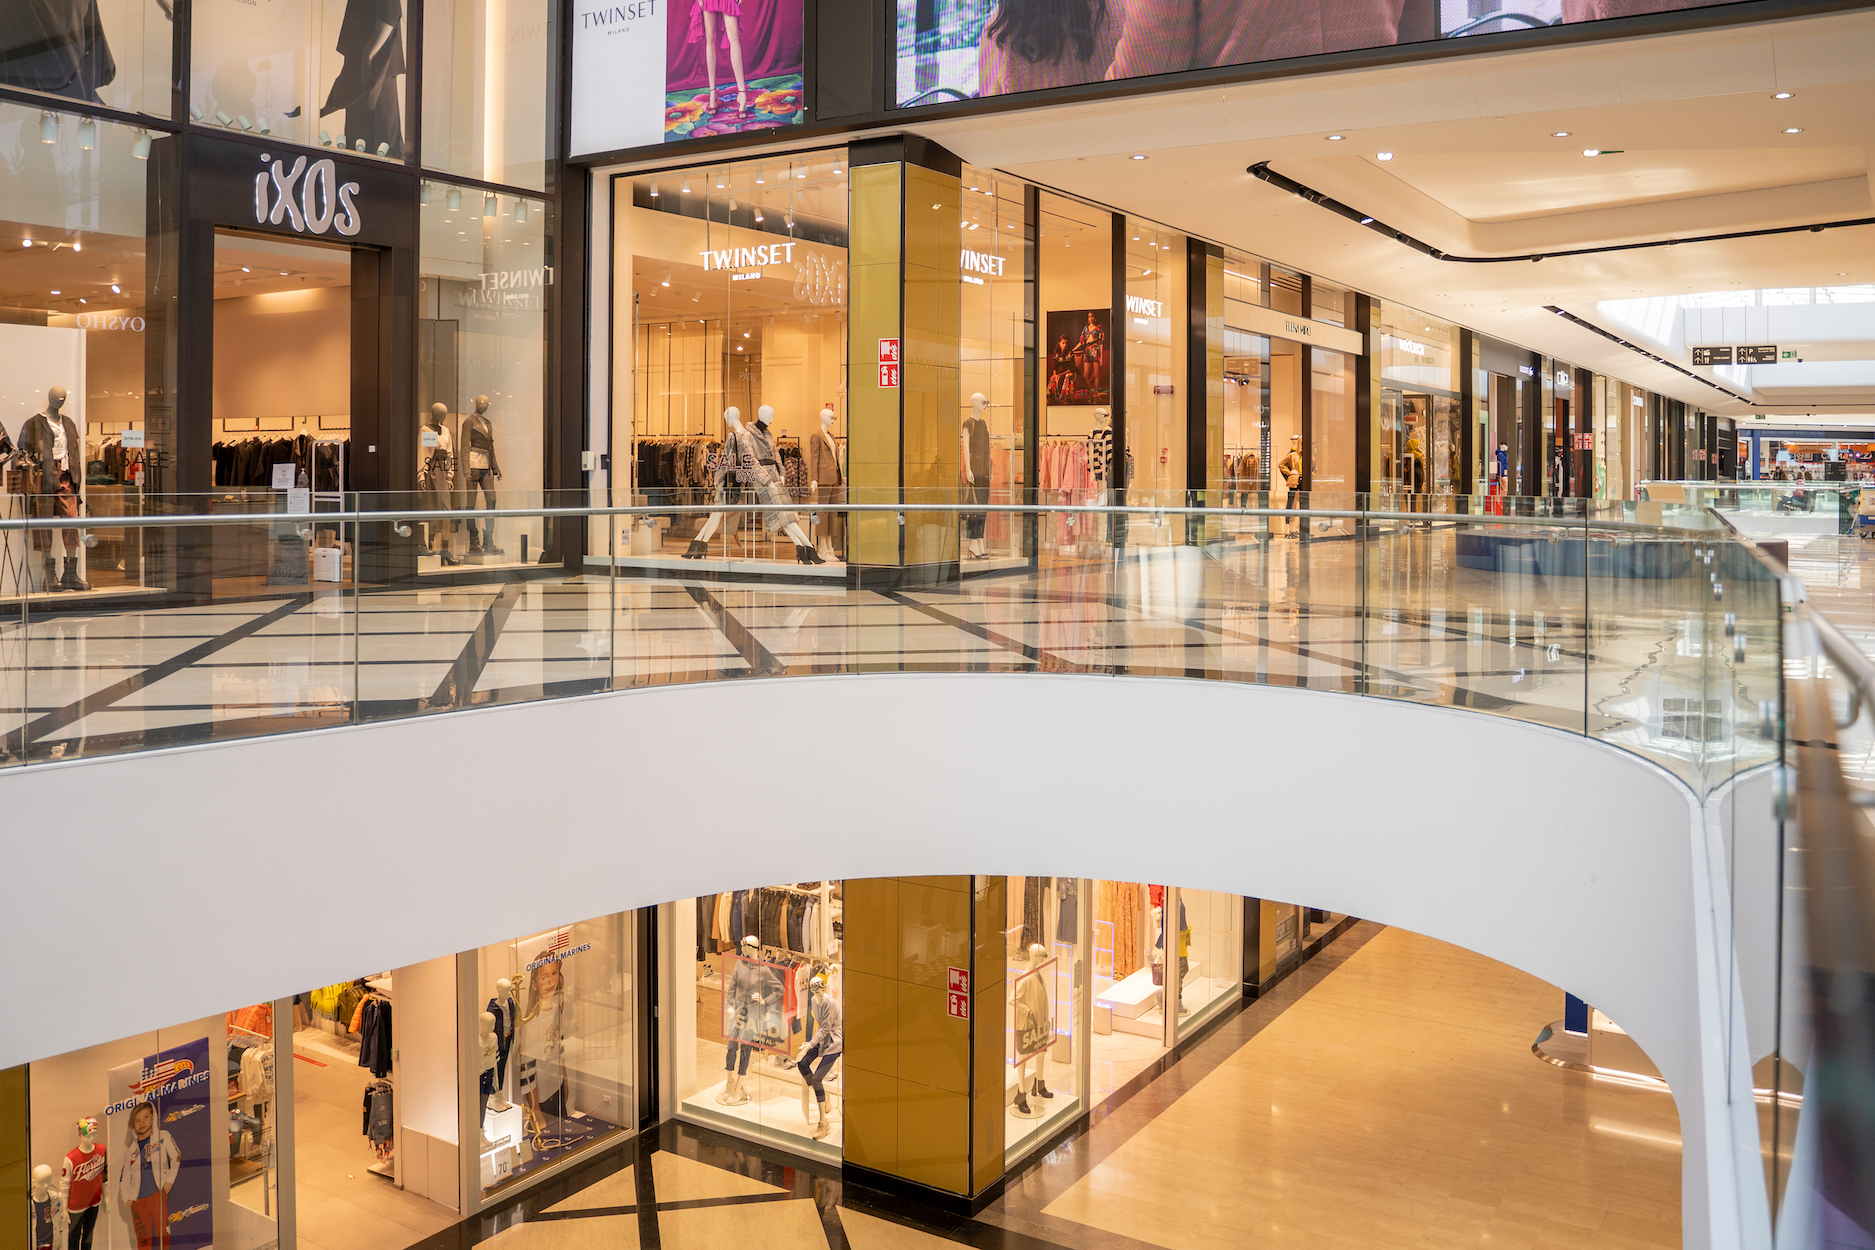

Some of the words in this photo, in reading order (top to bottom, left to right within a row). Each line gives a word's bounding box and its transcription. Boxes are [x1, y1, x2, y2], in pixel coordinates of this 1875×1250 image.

[581, 0, 657, 30] TWINSET
[607, 27, 630, 36] MILANO
[699, 242, 796, 271] TWINSET
[960, 249, 1006, 276] INSET
[732, 272, 762, 281] MILANO
[1125, 294, 1163, 318] WINSET
[119, 448, 169, 469] SALE
[424, 456, 458, 472] SALE
[706, 452, 753, 472] SALE
[526, 953, 560, 972] ORIGINAL
[560, 942, 591, 960] MARINES
[103, 1087, 160, 1116] ORIGINAL
[160, 1070, 210, 1097] MARINES
